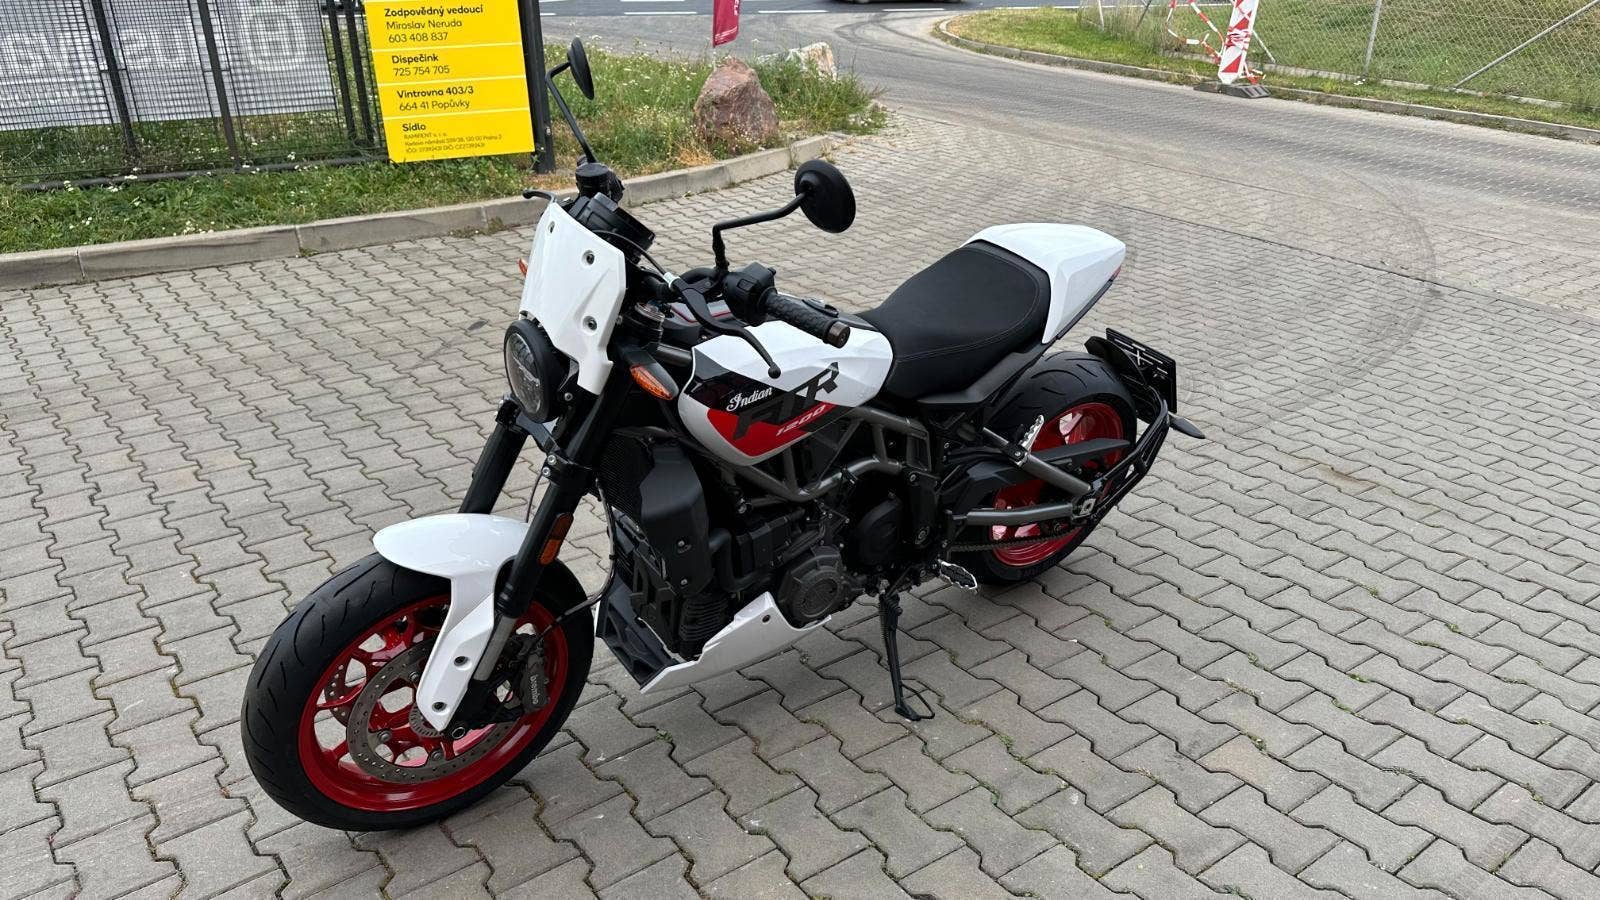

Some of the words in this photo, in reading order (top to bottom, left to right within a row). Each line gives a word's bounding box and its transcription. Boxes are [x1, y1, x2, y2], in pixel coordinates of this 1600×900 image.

[384, 6, 445, 18] Zodpovědný
[447, 4, 484, 14] vedoucí
[386, 20, 426, 30] Miroslav
[428, 19, 463, 28] Neruda
[388, 33, 407, 43] 603
[409, 32, 429, 42] 408
[430, 32, 449, 41] 837
[391, 53, 439, 65] Dispečink
[393, 67, 411, 77] 725
[413, 66, 430, 76] 754
[433, 65, 450, 75] 705
[396, 88, 444, 99] Vintrovna
[445, 86, 474, 96] 403/3
[399, 102, 418, 111] 664
[420, 101, 429, 110] 41
[432, 99, 470, 110] Popůvky
[402, 122, 426, 132] Sídlo
[726, 387, 773, 412] Indian
[776, 404, 826, 437] 1200
